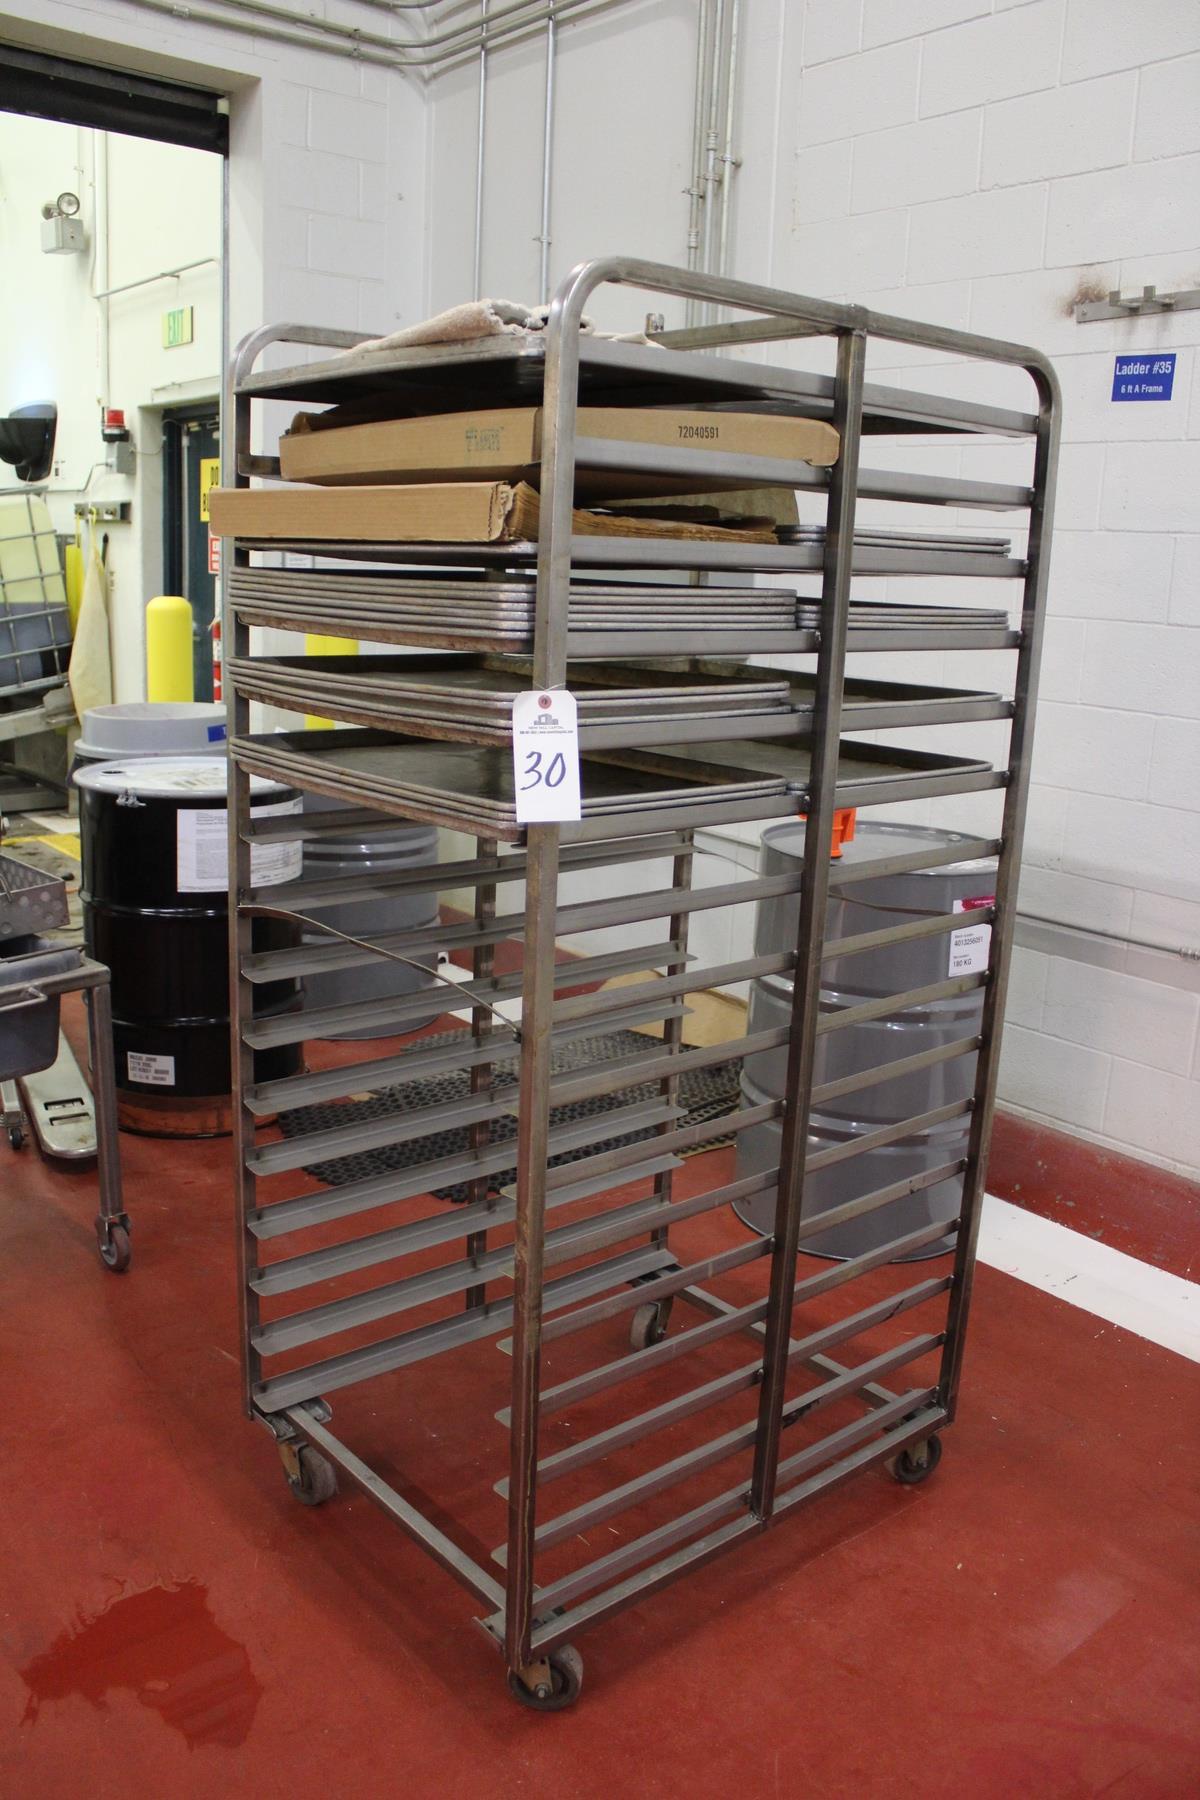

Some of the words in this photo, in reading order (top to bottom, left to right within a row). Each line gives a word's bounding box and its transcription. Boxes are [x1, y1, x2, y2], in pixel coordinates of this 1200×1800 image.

[168, 309, 184, 345] EXIT
[1116, 362, 1150, 375] Ladder
[1152, 361, 1172, 374] #35
[1121, 385, 1126, 394] 6
[1127, 384, 1133, 394] ft
[1134, 384, 1140, 393] A
[1141, 384, 1163, 393] Frame
[678, 425, 719, 439] 72040591
[520, 751, 566, 791] 30
[963, 958, 972, 966] KG
